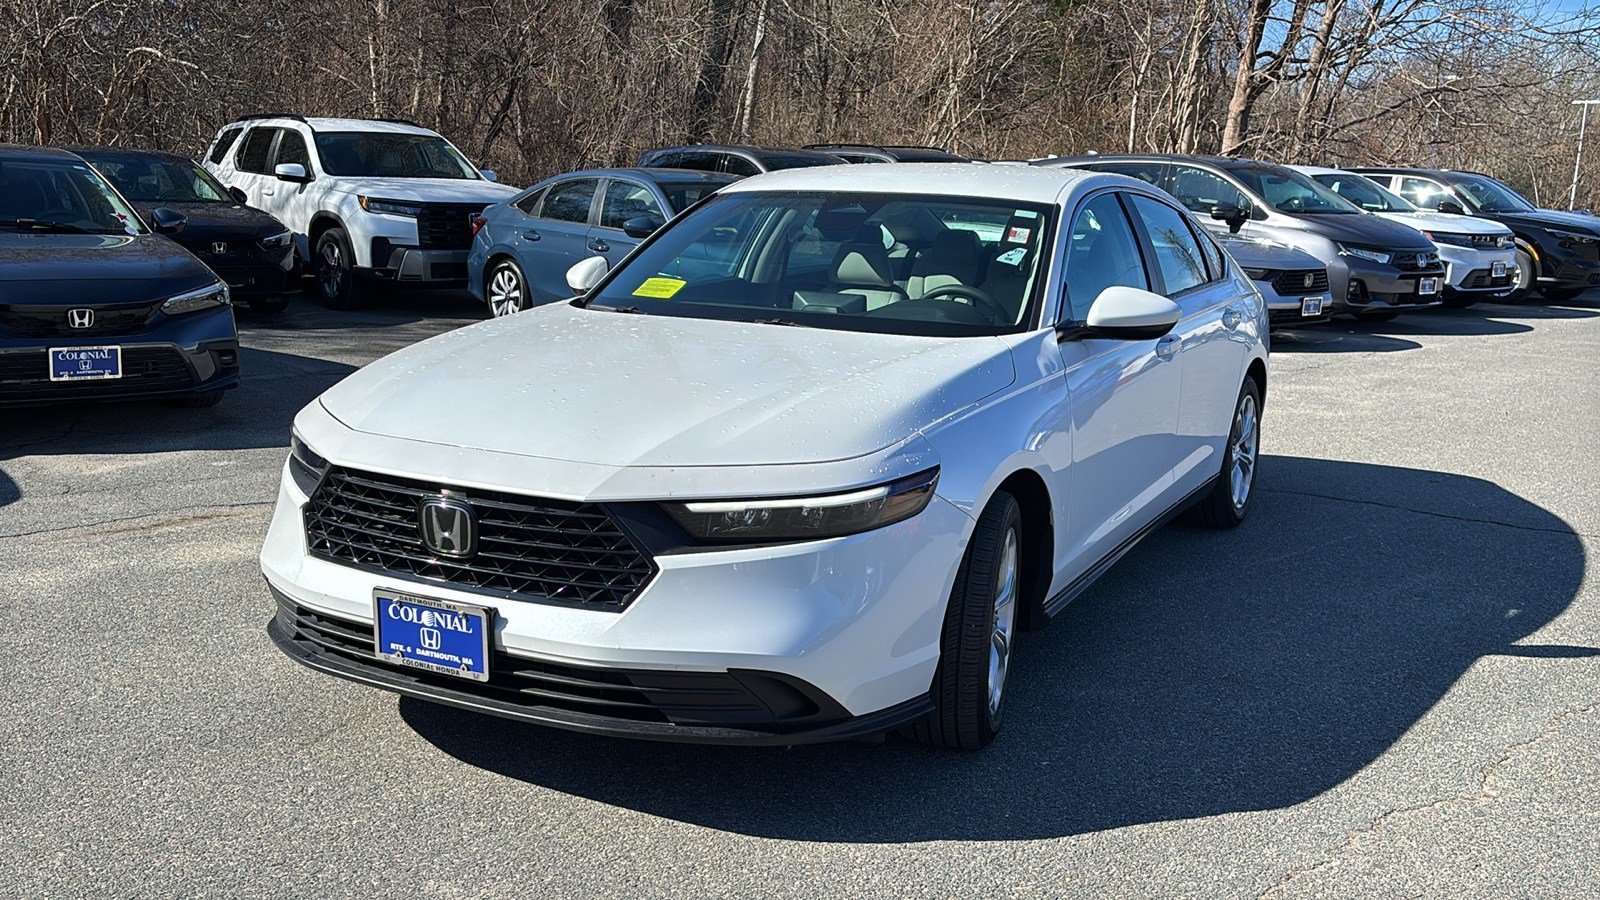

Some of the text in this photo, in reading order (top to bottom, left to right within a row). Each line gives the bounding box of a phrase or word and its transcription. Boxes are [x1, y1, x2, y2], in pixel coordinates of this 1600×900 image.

[58, 351, 112, 361] COLONIAL
[447, 603, 458, 611] MA
[388, 603, 473, 634] COLONIAL
[390, 642, 406, 652] RTE.
[416, 647, 461, 663] DARTMOUTH,
[461, 657, 474, 666] MA
[402, 658, 460, 676] COLONIAL HONDA
